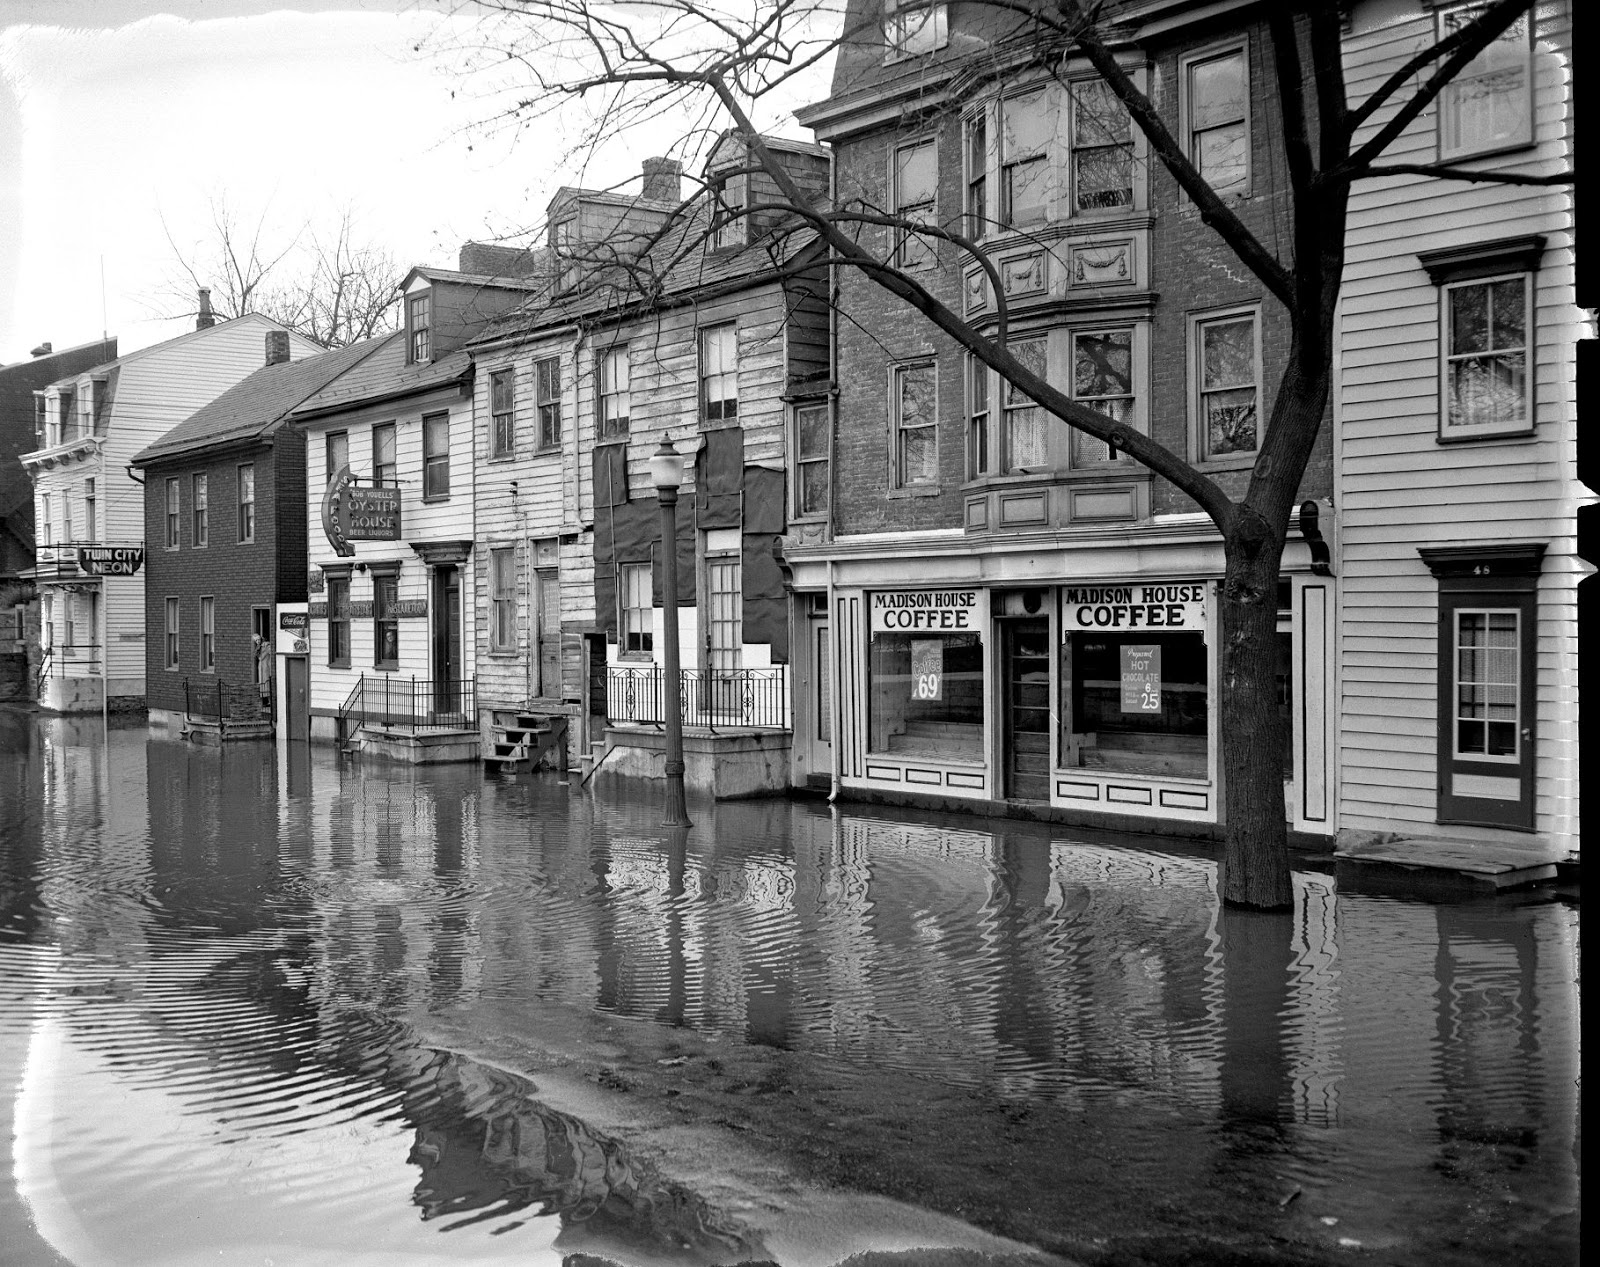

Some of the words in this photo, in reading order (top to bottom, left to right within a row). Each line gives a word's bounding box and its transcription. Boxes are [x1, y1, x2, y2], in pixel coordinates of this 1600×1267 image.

[348, 500, 397, 512] OYSTER
[351, 516, 394, 528] HOUSE
[368, 529, 394, 537] LIQUORS
[83, 549, 113, 560] TWIN
[114, 549, 142, 560] CITY
[92, 562, 133, 574] NEON
[1473, 565, 1490, 575] 48
[875, 593, 933, 608] MADISON
[934, 592, 976, 607] HOUSE
[1066, 588, 1133, 604] MADISON
[1141, 586, 1204, 603] HOUSE
[883, 609, 969, 629] COFFEE
[1076, 604, 1185, 627] COFFEE
[912, 656, 942, 679] Coffee
[1131, 660, 1149, 671] HOT
[1122, 673, 1159, 683] CHOCOLATE
[1144, 682, 1152, 693] 6
